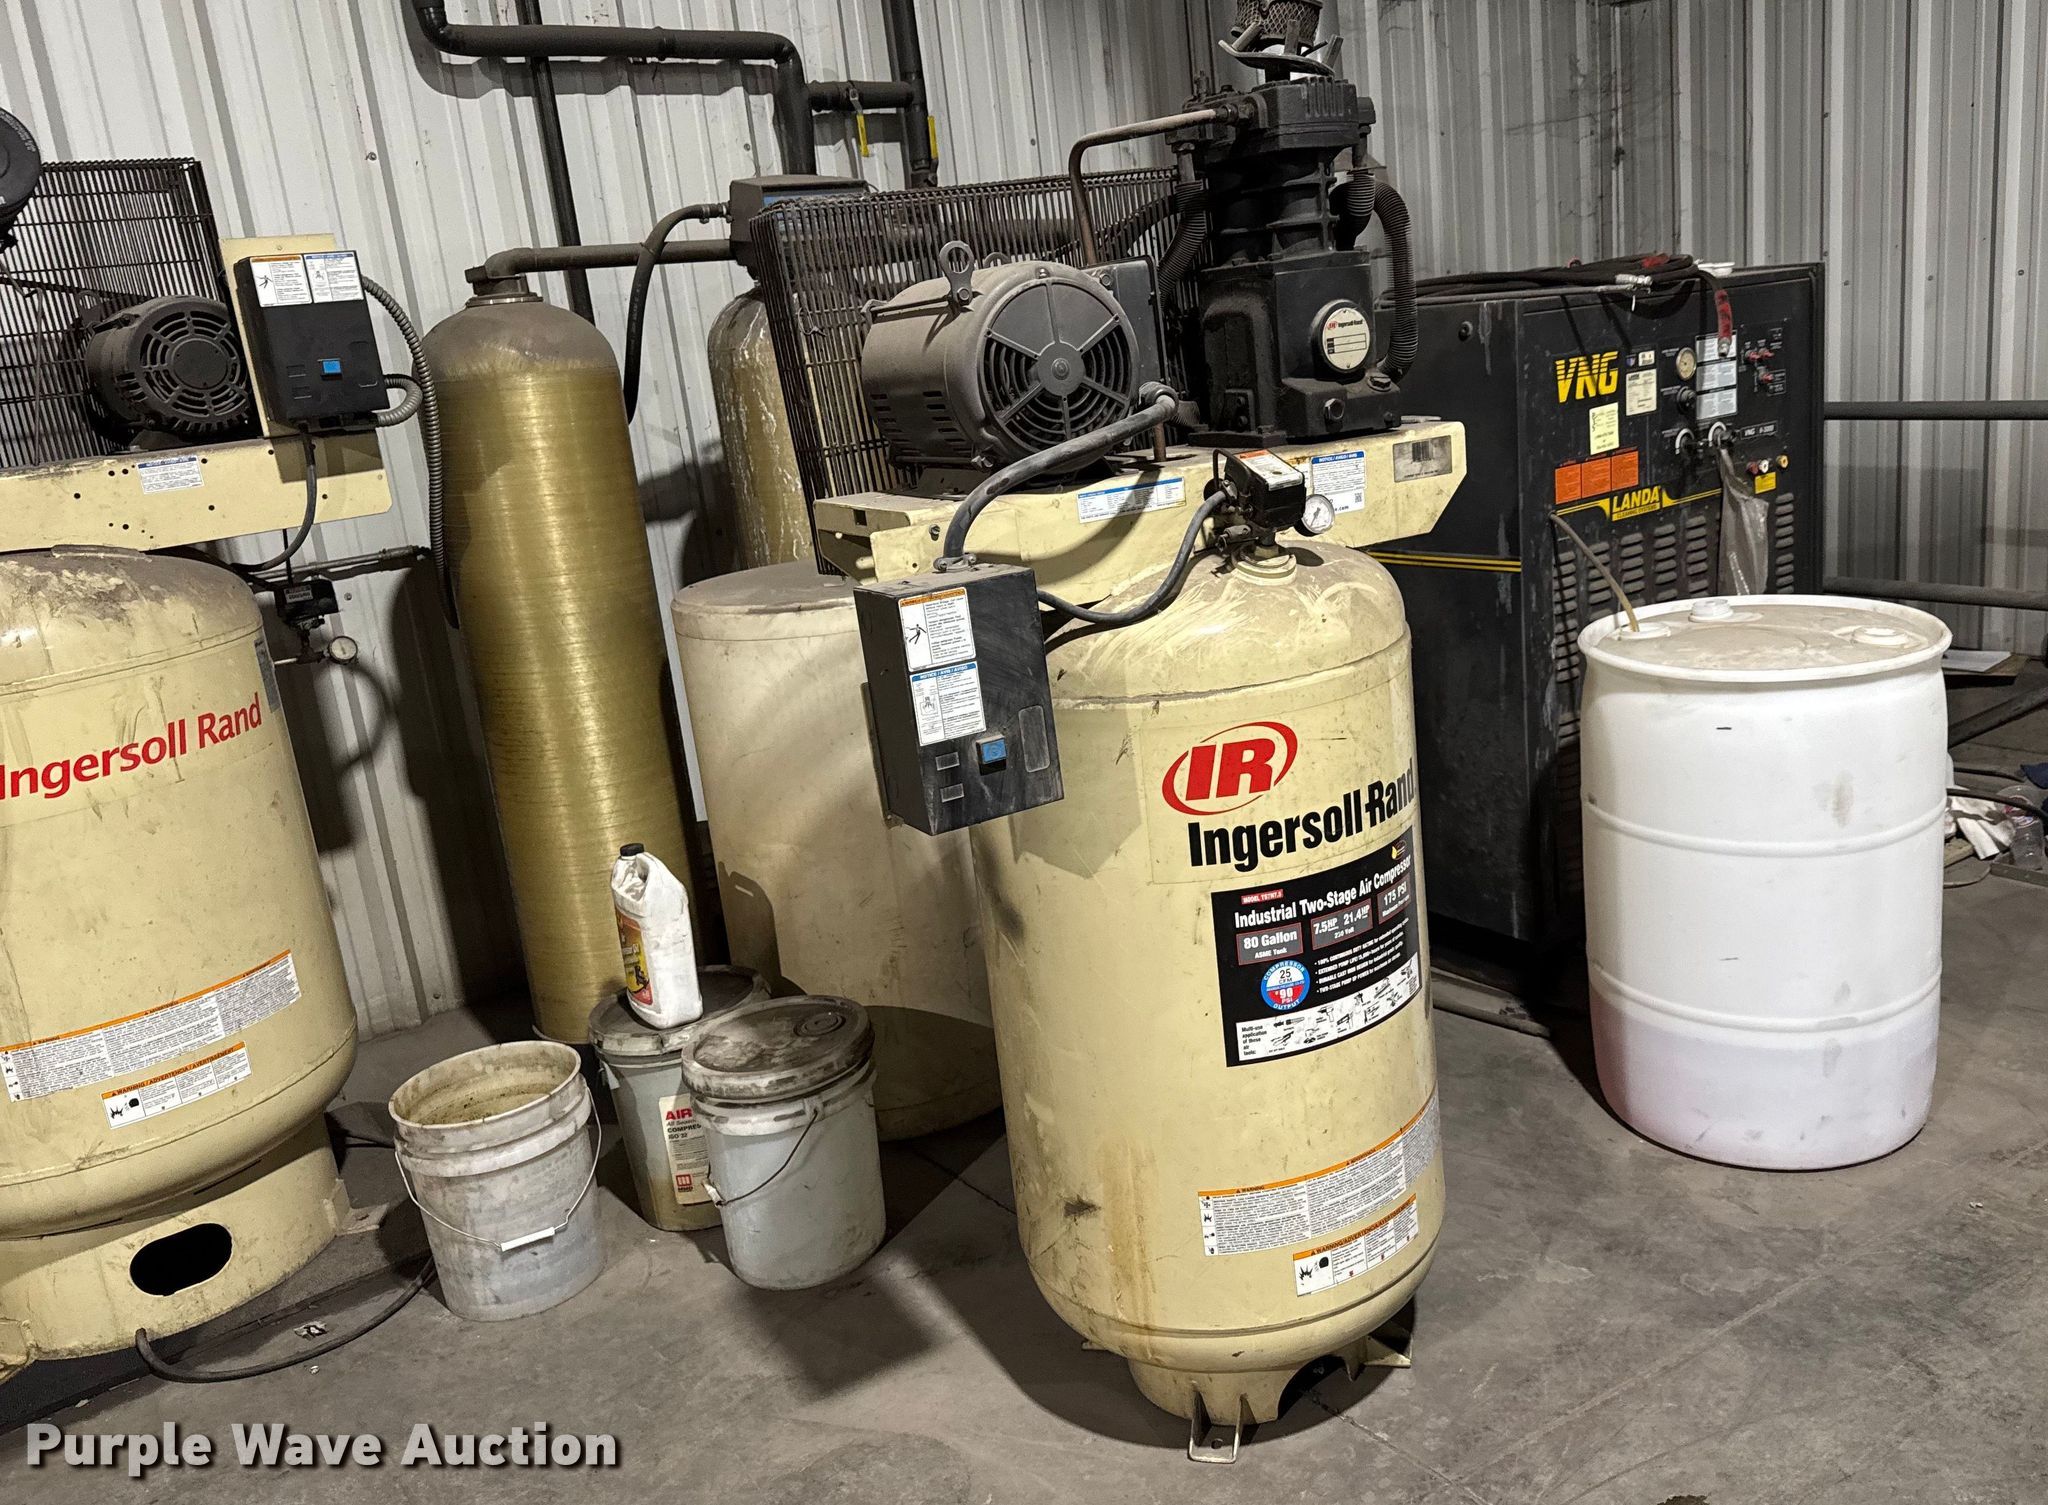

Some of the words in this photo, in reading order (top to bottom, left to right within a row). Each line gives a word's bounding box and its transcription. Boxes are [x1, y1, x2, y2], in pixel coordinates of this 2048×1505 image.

[1555, 351, 1618, 403] VNG
[1612, 485, 1661, 513] LANDA
[0, 718, 187, 800] Ingersoll
[198, 692, 262, 749] Rand
[1185, 738, 1276, 801] IR
[1234, 901, 1297, 929] Industrial
[1299, 887, 1357, 916] Two-Stage
[1359, 878, 1373, 897] Air
[1373, 854, 1411, 889] Compressor
[1384, 889, 1397, 906] 175
[1397, 881, 1407, 898] PSI
[1243, 936, 1259, 950] 80
[1261, 931, 1298, 946] Gallon
[1255, 949, 1272, 959] ASME
[1264, 960, 1305, 980] COMPRESSOR
[1280, 968, 1291, 979] 25
[1273, 999, 1300, 1010] OUTPUT
[1242, 1031, 1267, 1039] application
[117, 1082, 145, 1096] WARNING
[149, 1066, 188, 1086] ADVERTENCIA
[193, 1047, 235, 1069] AVERTISSEMENT
[666, 1106, 693, 1120] AIR
